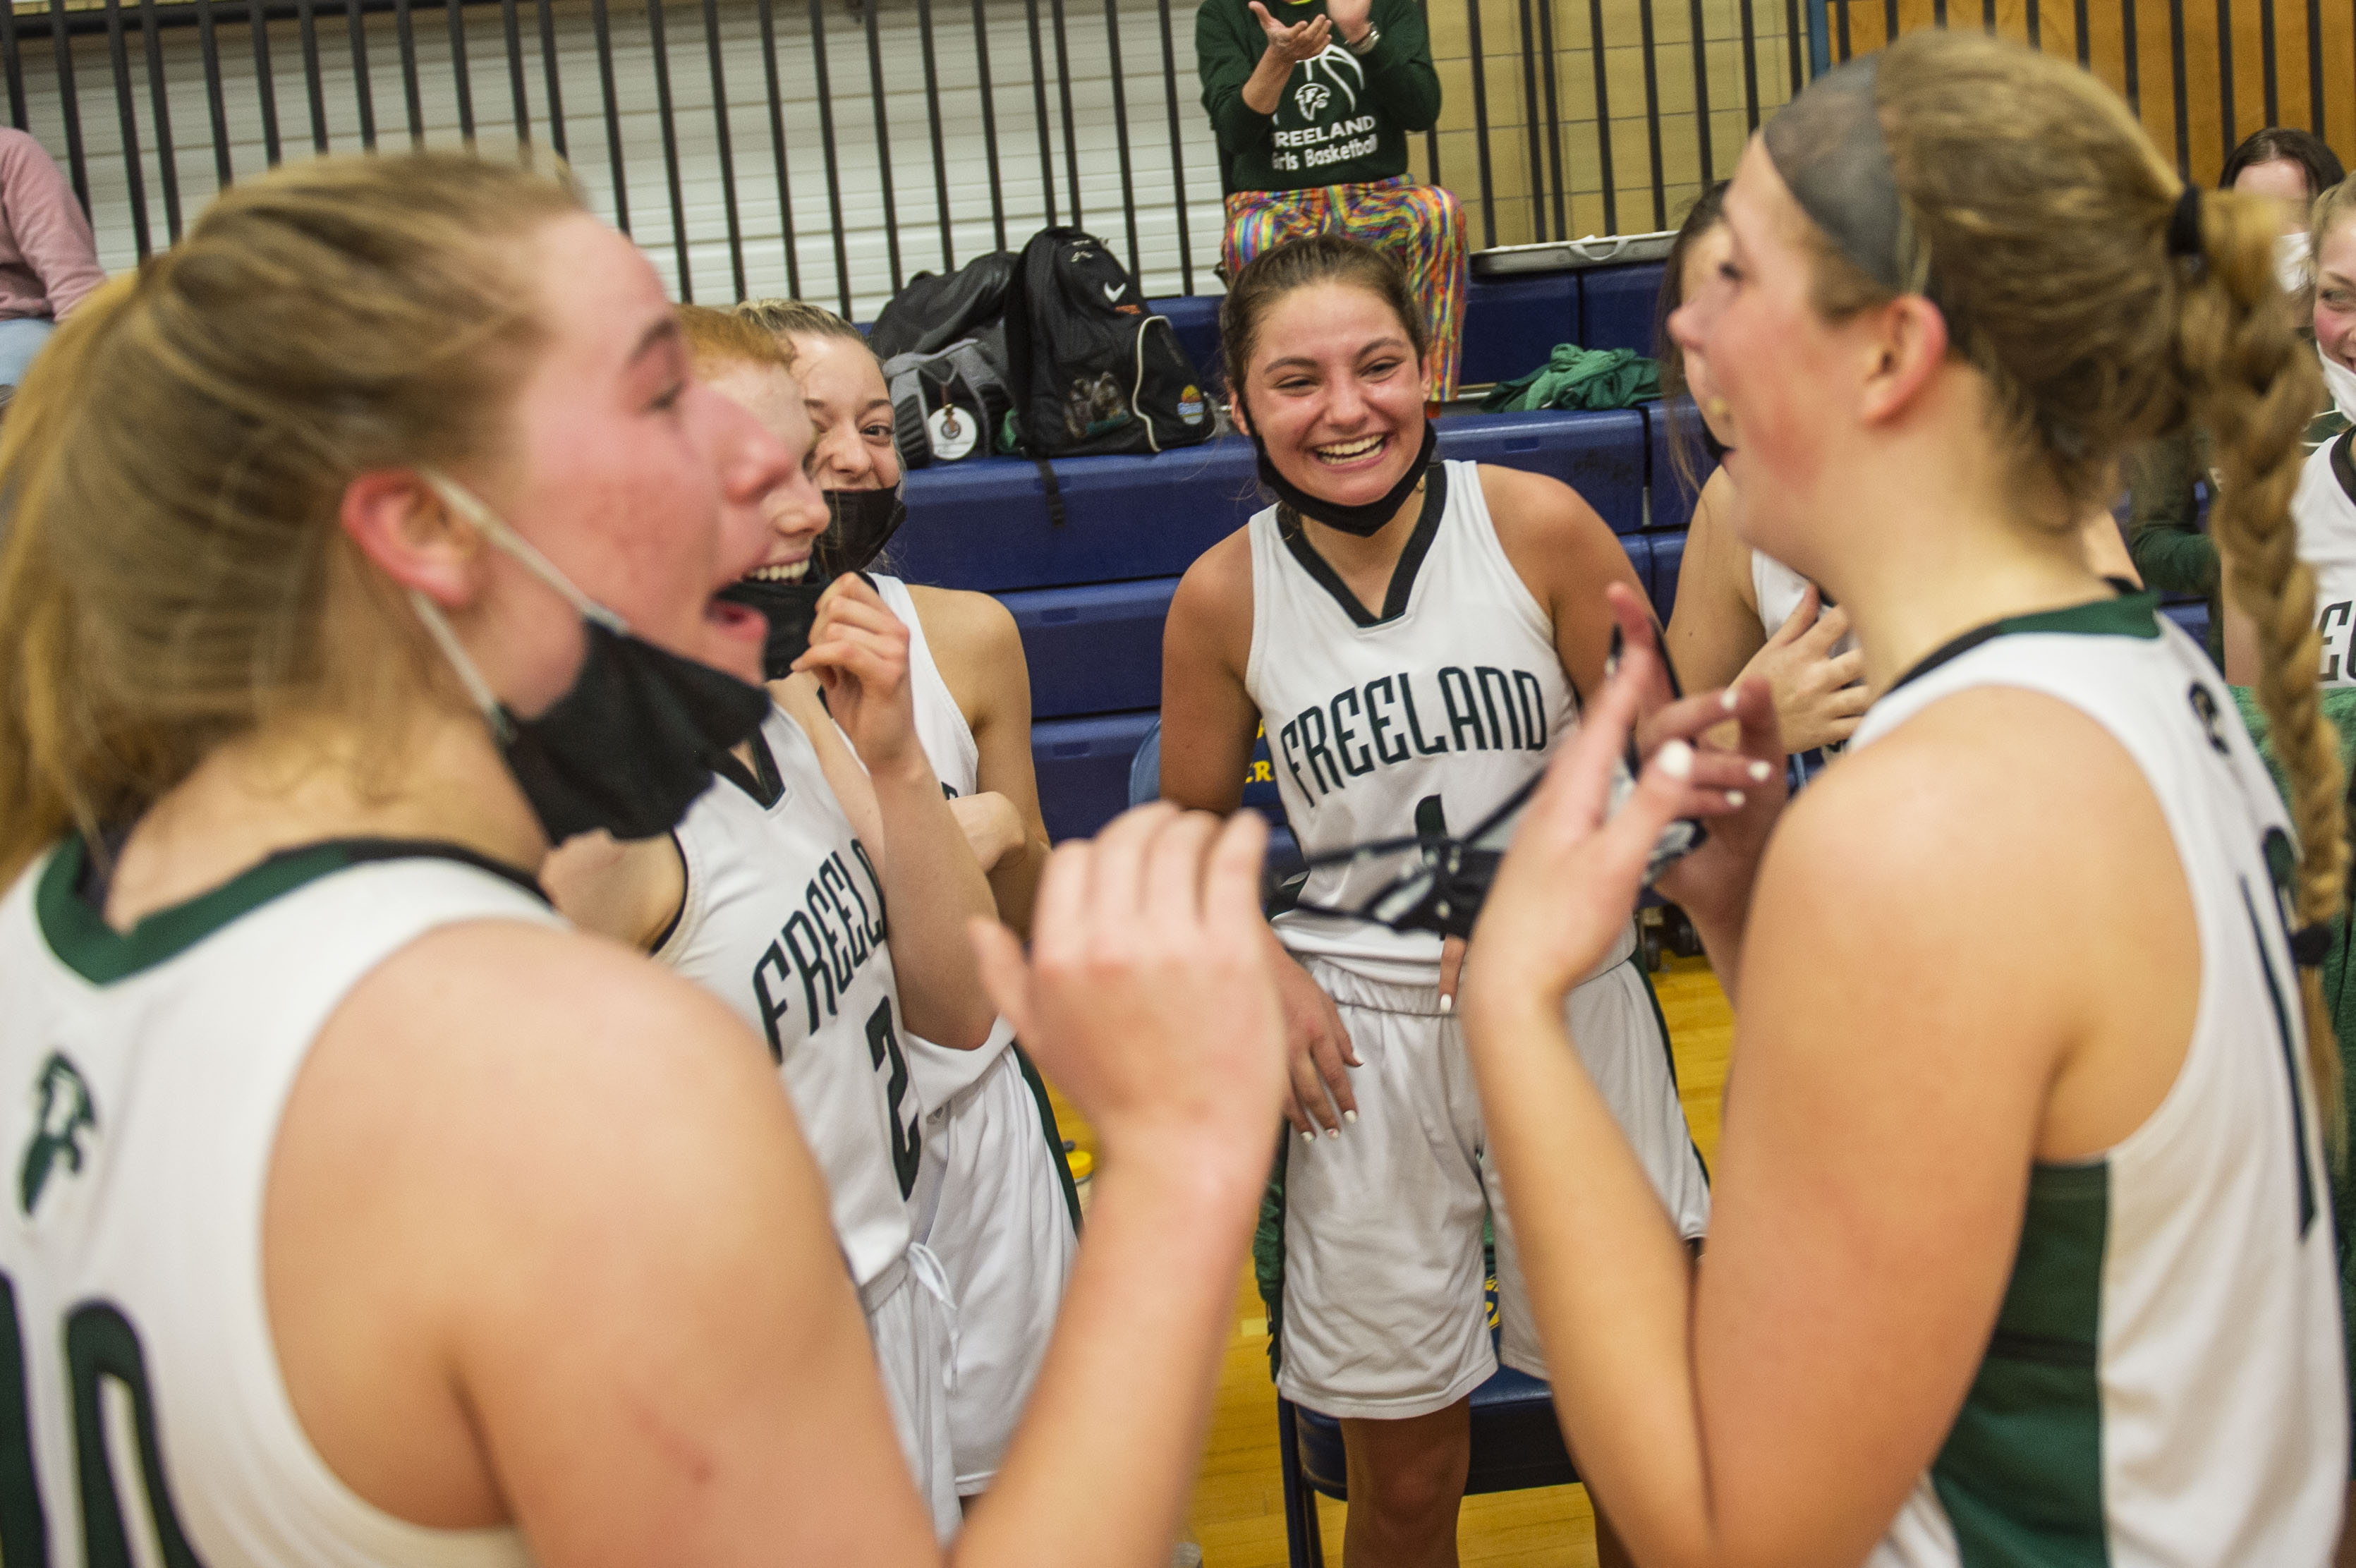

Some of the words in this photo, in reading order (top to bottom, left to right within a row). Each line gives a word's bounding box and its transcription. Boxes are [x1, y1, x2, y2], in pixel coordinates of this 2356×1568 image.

[1274, 115, 1376, 148] REELAND
[1280, 666, 1547, 808] FREELAND
[865, 995, 921, 1202] 2
